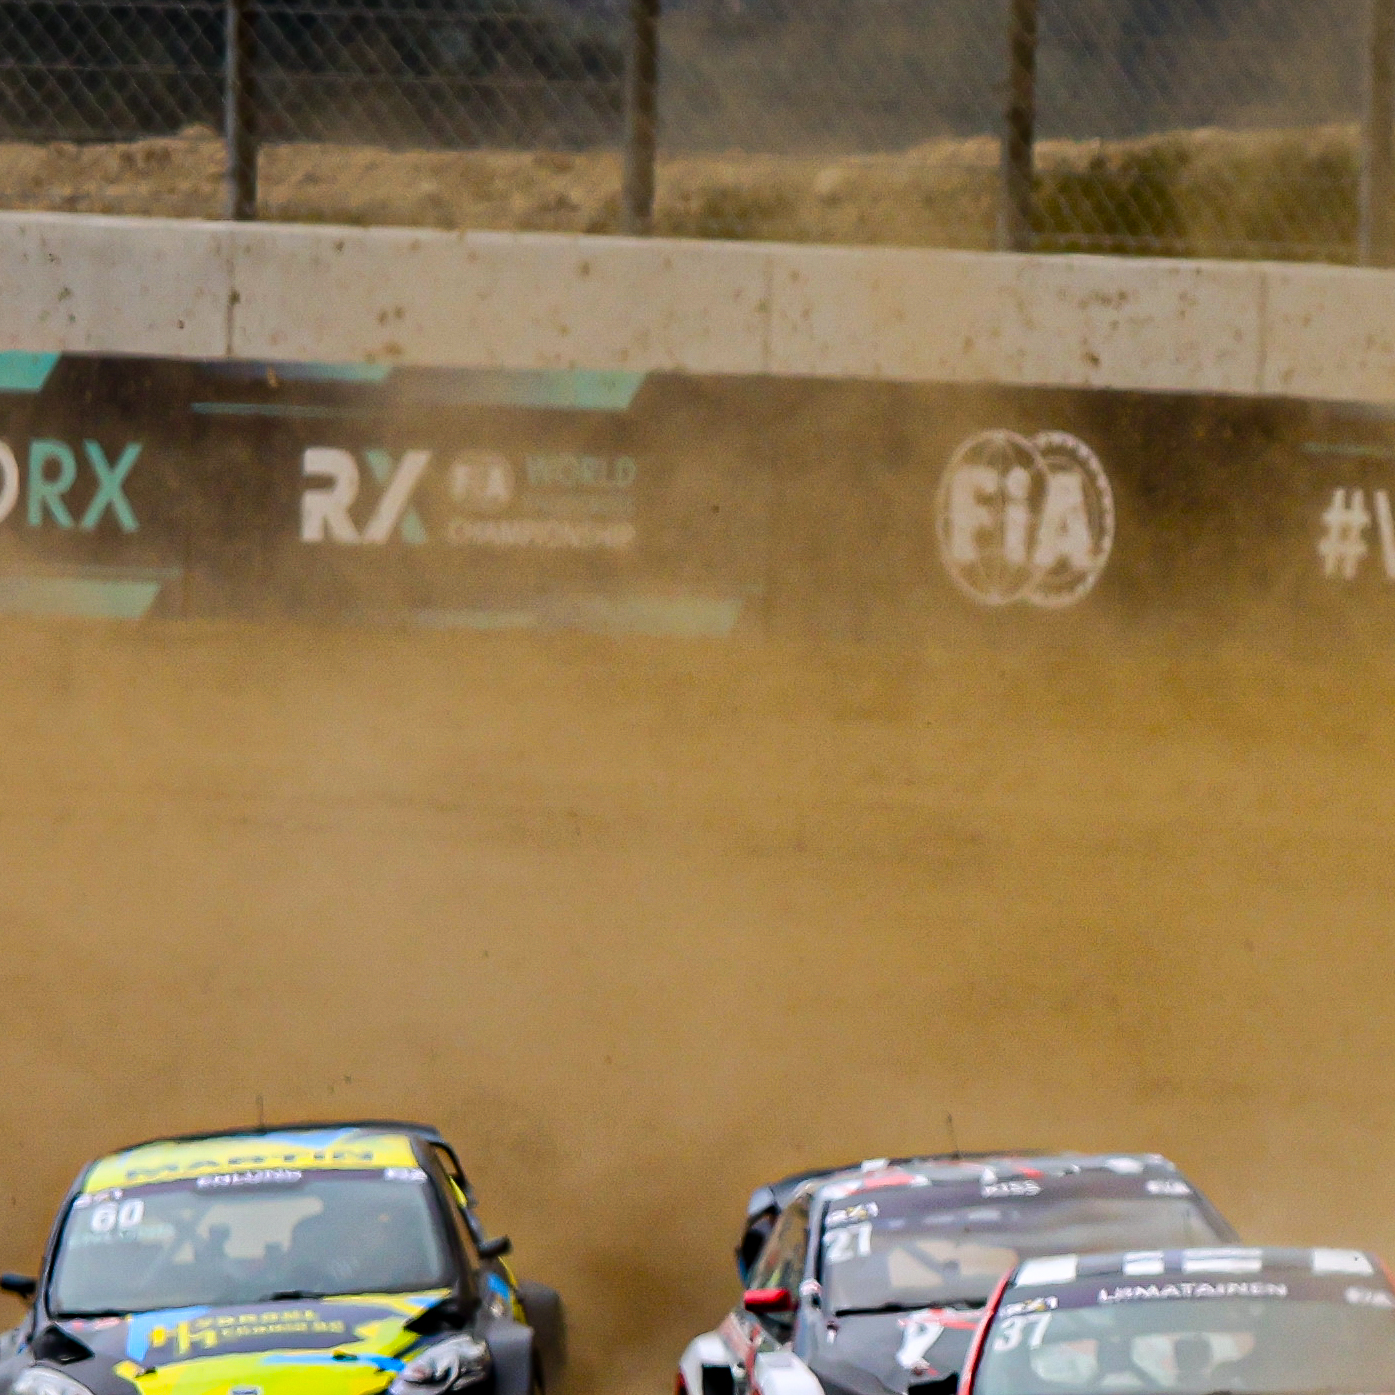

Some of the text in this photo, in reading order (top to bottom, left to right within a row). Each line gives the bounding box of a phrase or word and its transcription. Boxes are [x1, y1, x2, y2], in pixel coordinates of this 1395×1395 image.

[524, 453, 637, 487] WORLD
[299, 446, 433, 545] RX
[993, 1312, 1053, 1351] 37
